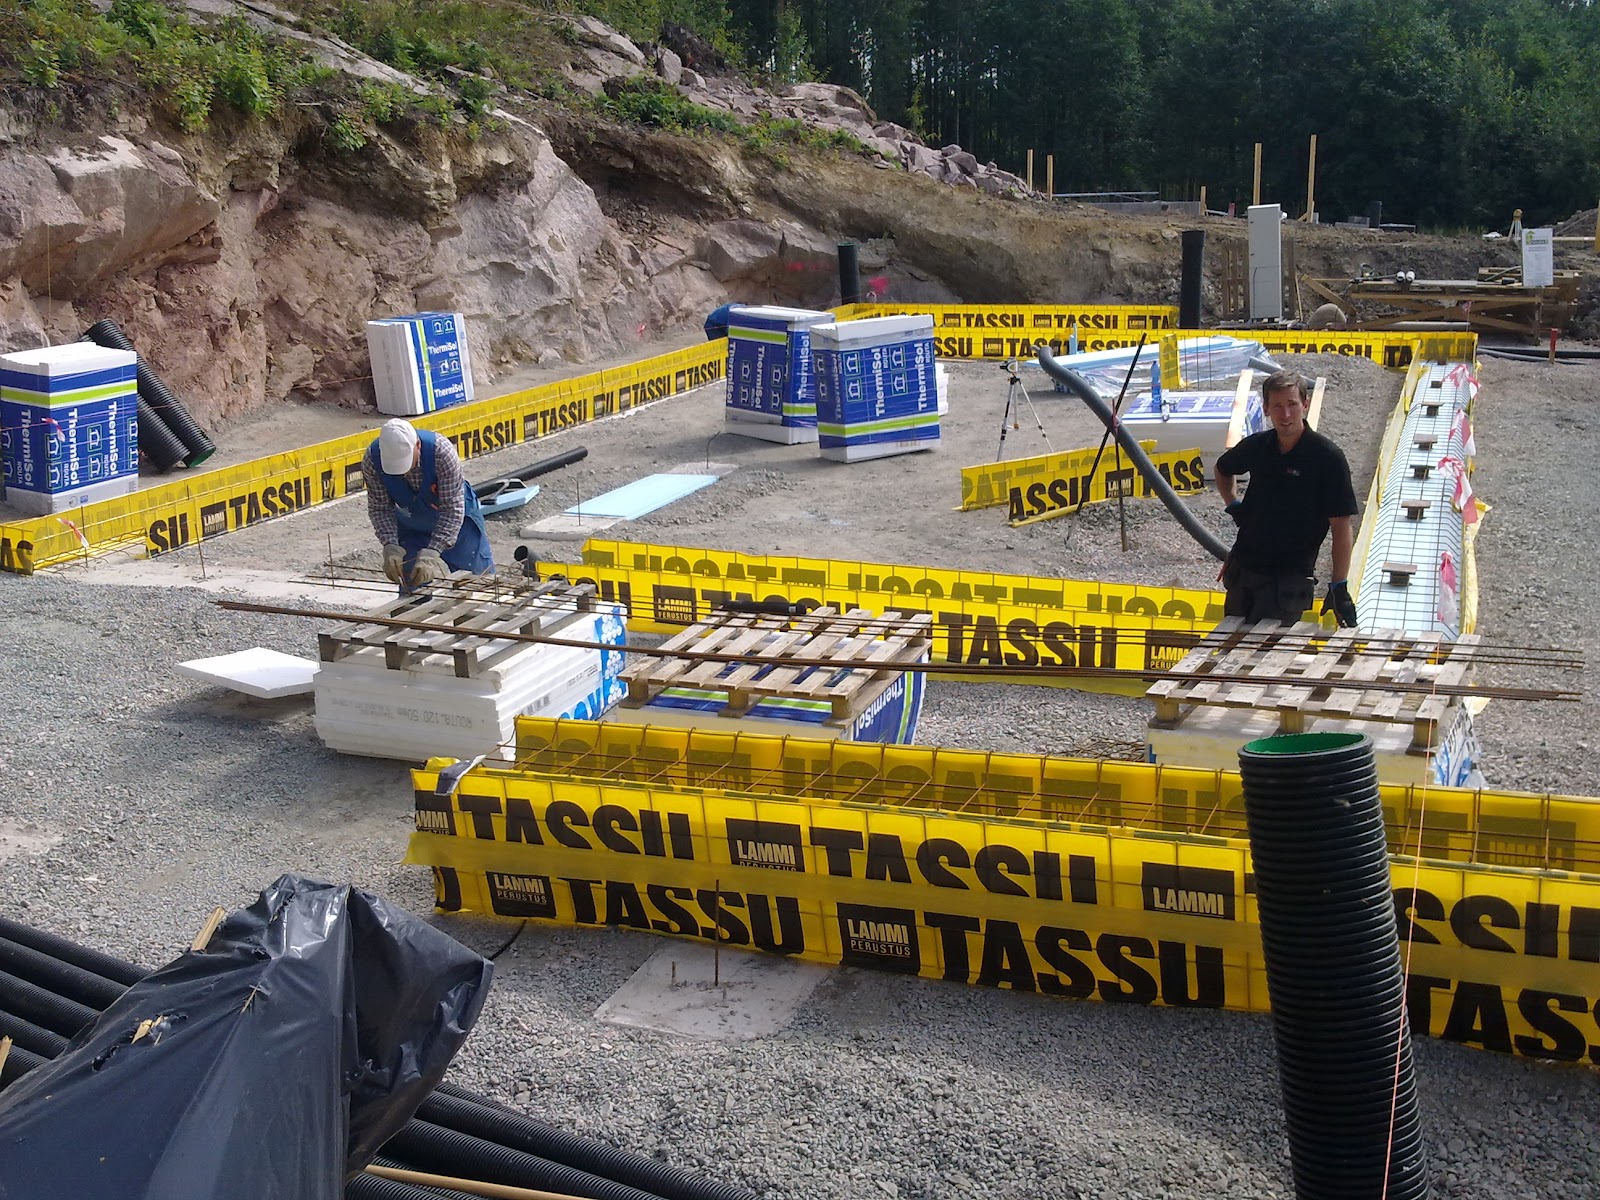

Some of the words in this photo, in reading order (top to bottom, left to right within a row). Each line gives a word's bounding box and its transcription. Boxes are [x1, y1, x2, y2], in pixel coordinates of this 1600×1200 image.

[963, 314, 1024, 328] TASSU
[1054, 314, 1119, 329] TASSU
[632, 374, 671, 408] TASSU
[540, 398, 588, 438] TASSU
[459, 418, 516, 458] TASSU
[229, 475, 312, 528] TASSU
[658, 611, 693, 622] PERUSTUS
[938, 611, 1118, 668] TASSU
[457, 793, 694, 860] TASSU
[736, 839, 796, 865] LAMMI
[809, 826, 1097, 904] TASSU
[494, 873, 546, 894] LAMMI
[497, 890, 548, 904] PERUSTUS
[556, 876, 805, 956] TASSU
[1152, 886, 1224, 916] LAMMI
[847, 918, 909, 945] LAMMI
[850, 940, 911, 957] PERUSTUS
[923, 911, 1226, 1009] TASSU
